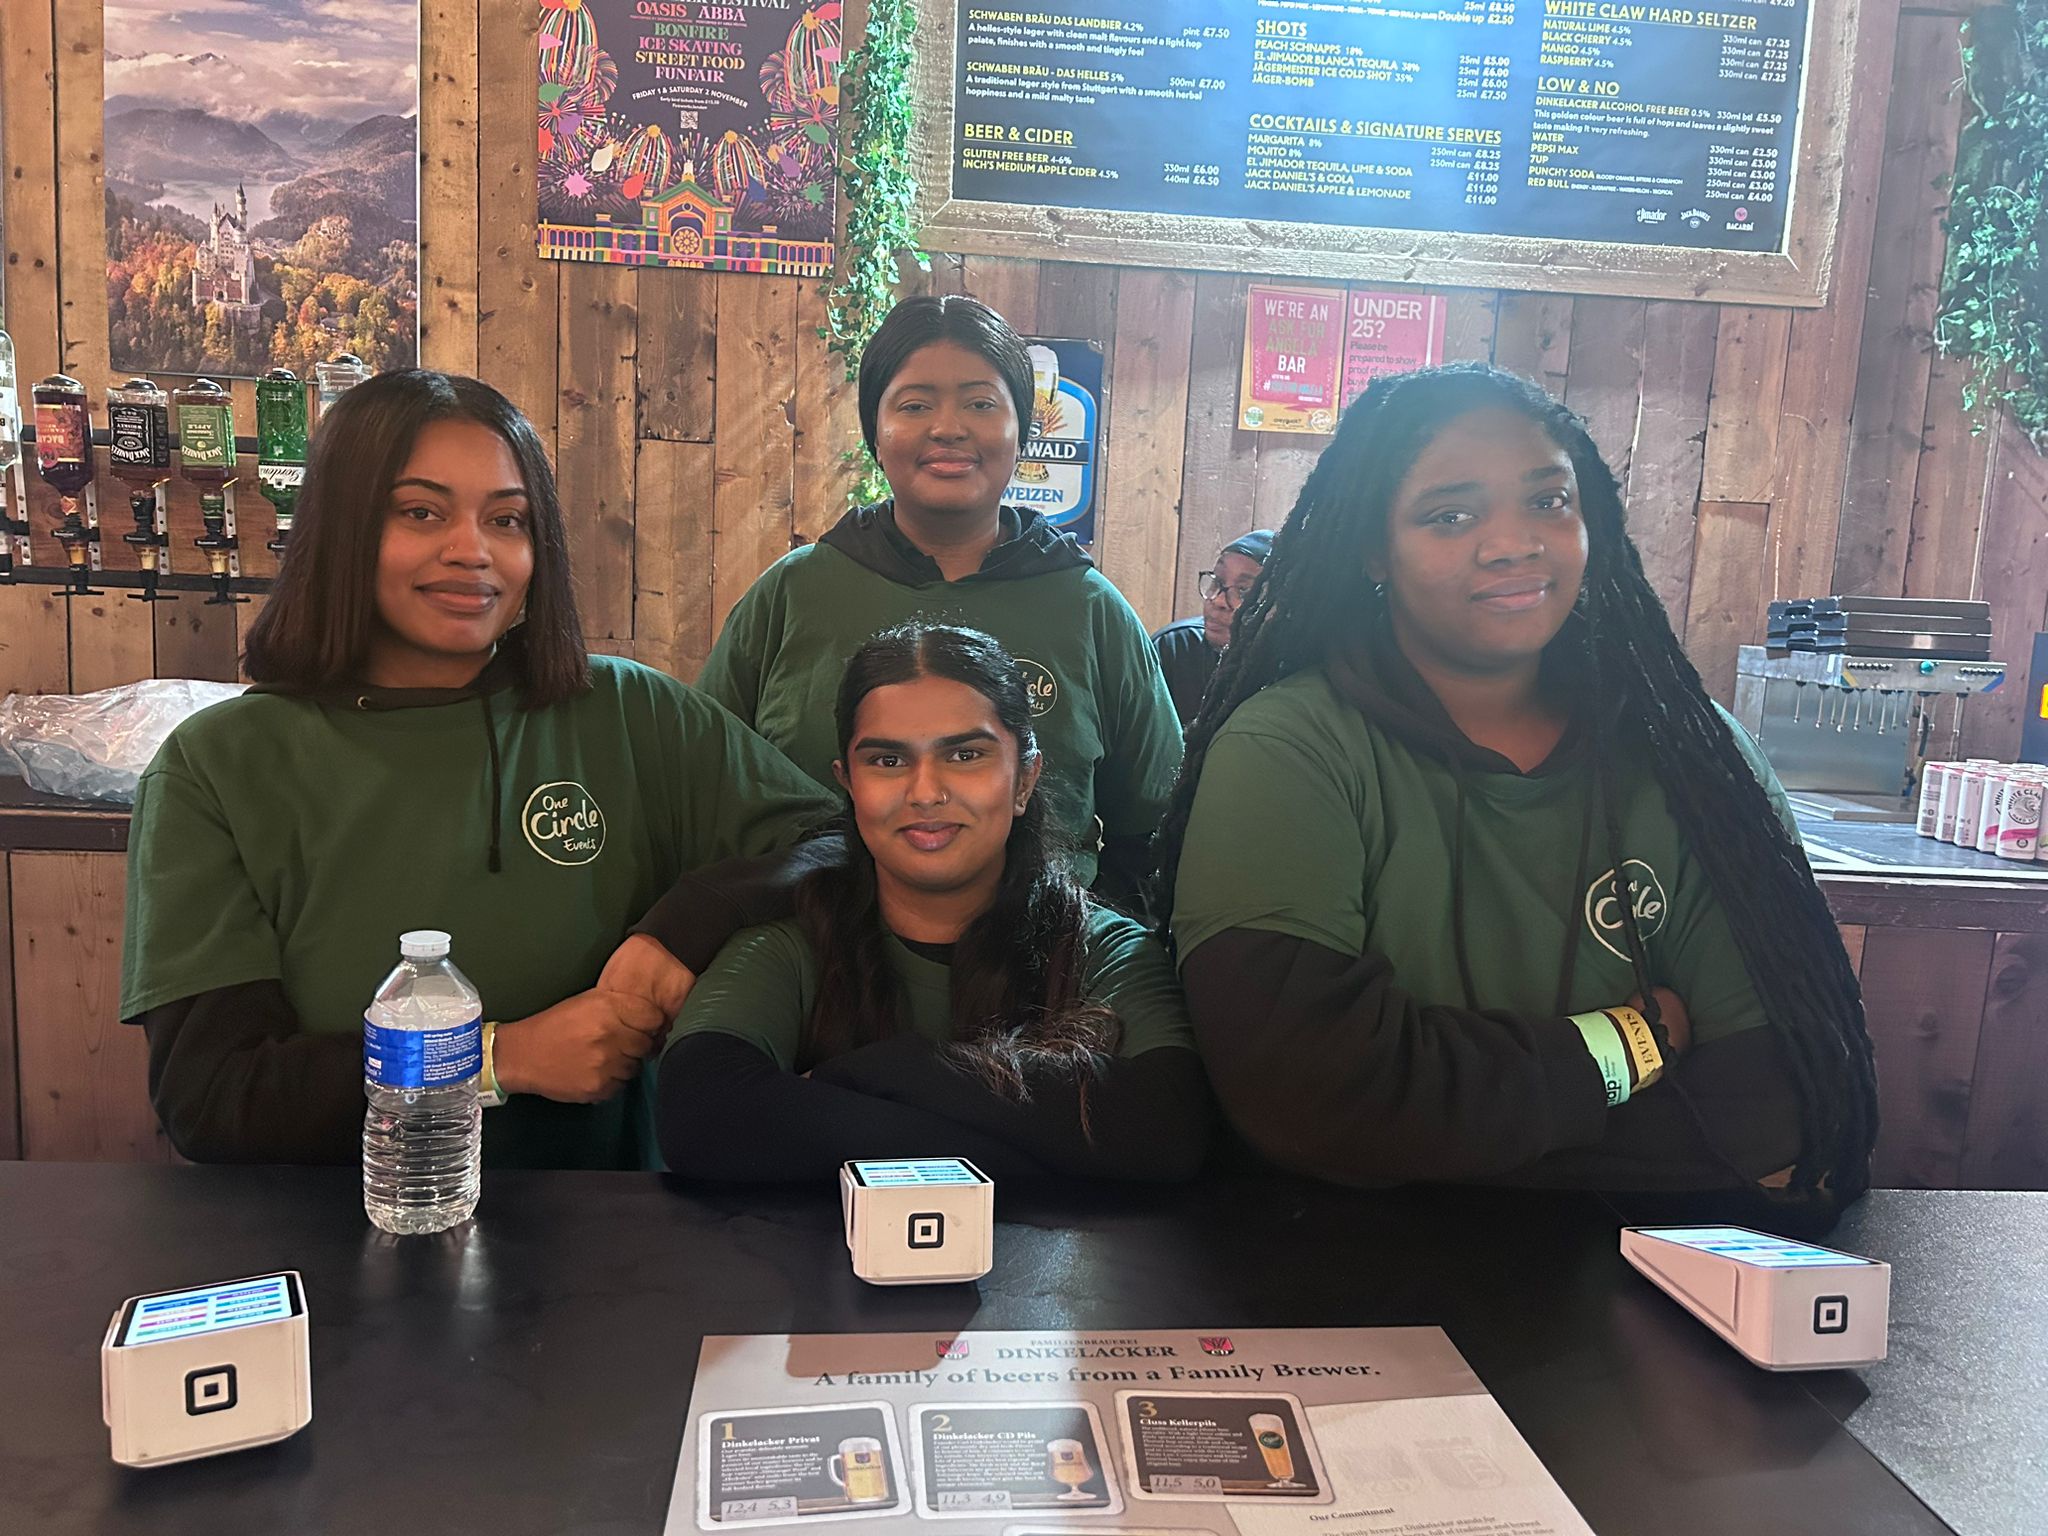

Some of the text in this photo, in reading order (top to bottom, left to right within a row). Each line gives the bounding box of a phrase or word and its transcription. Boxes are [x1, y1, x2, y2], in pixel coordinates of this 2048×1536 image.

[636, 1, 687, 18] OASIS
[698, 6, 745, 21] ABBA
[1545, 0, 1757, 30] WHITE CLAW HARD SELTZER
[969, 10, 1144, 32] SCHWABEN BRÄU DAS LANDBIER 4.2%
[1256, 20, 1307, 36] SHOTS
[1543, 20, 1631, 34] NATURAL LIME 4.5%
[654, 23, 728, 40] BONFIRE
[1183, 27, 1230, 38] pint £7.50
[1542, 32, 1632, 46] BLACK CHERRY 4.5%
[1723, 35, 1790, 48] 330ml can £7.25
[640, 37, 742, 56] ICE SKATING
[1541, 43, 1600, 56] MANGO 4.5%
[1722, 47, 1746, 56] 330ml
[1764, 50, 1789, 60] £7.25
[636, 51, 745, 70] STREET FOOD
[1540, 55, 1614, 68] RASPBERRY 4.5%
[656, 66, 724, 82] FUNFAIR
[1252, 73, 1314, 87] JÄGER-BOMB
[1170, 77, 1225, 90] 500ml £7.00
[1538, 76, 1620, 95] LOW & NO
[632, 89, 656, 100] FRIDAY
[669, 86, 703, 95] SATURDAY
[711, 90, 748, 109] NOVEMBER
[1536, 97, 1710, 118] DINKELACKER ALCOHOL FREE BEER 0.5%
[964, 123, 1073, 145] BEER & CIDER
[1250, 114, 1501, 144] COCKTAILS & SIGNATURE SERVES
[1532, 132, 1564, 142] WATER
[963, 148, 1000, 160] GLUTEN
[1002, 151, 1024, 161] FREE
[1026, 152, 1049, 163] BEER
[1531, 144, 1579, 154] PEPSI MAX
[1530, 155, 1549, 164] 7UP
[963, 159, 1118, 178] INCH'S MEDIUM APPLE CIDER 4.5%
[1164, 164, 1219, 175] 330ml £6.00
[1529, 166, 1568, 176] PUNCHY
[1569, 169, 1594, 179] SODA
[1164, 175, 1220, 186] 440ml £6.50
[1468, 172, 1498, 182] £11.00
[1528, 178, 1545, 187] RED
[1548, 180, 1569, 189] BULL
[1245, 180, 1411, 199] JACK DANIEL'S APPLE & LEMONADE
[1466, 184, 1497, 193] £11.00
[1465, 195, 1496, 204] £11.00
[1264, 299, 1328, 321] WE'RE AN
[1354, 298, 1422, 320] UNDER
[1351, 320, 1385, 338] 25?
[1350, 341, 1388, 350] Please be
[1278, 355, 1306, 373] BAR
[1349, 355, 1385, 364] prepared
[1394, 356, 1416, 364] show
[1348, 366, 1370, 375] proof
[134, 448, 150, 461] JACK
[206, 446, 222, 459] JACK
[1002, 486, 1064, 502] WEIZEN
[1026, 676, 1053, 696] cle
[542, 796, 568, 810] One
[531, 800, 598, 839] Circle
[563, 838, 596, 851] Events
[1624, 1013, 1654, 1064] EVENTS
[1030, 1338, 1138, 1346] FAMILIENBRAUEREI
[997, 1346, 1178, 1360] DINKELACKER
[814, 1364, 1381, 1387] A family of beers from a Family Brewer.
[1139, 1401, 1158, 1417] 3
[931, 1414, 952, 1432] 2
[1169, 1419, 1216, 1427] Kellerpils
[722, 1422, 736, 1440] 1
[934, 1432, 994, 1440] Dinkelacker
[722, 1436, 820, 1448] Dinkelacker Privat
[1310, 1507, 1395, 1522] Our Commitment
